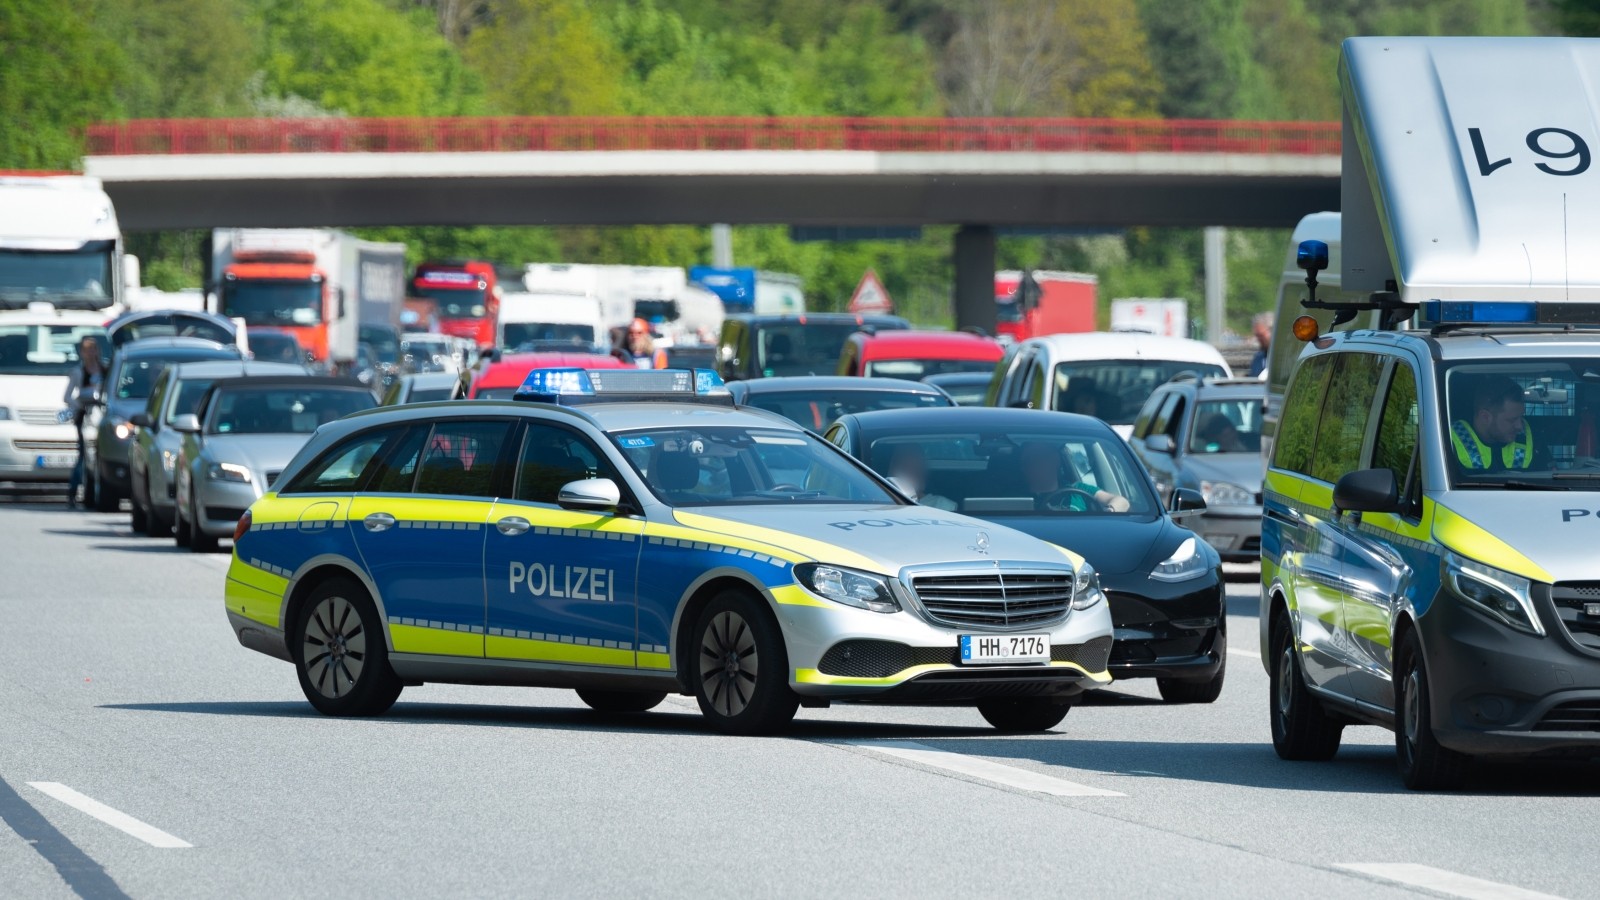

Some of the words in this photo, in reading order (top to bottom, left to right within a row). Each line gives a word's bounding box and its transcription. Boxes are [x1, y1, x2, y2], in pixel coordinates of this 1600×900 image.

[1562, 509, 1600, 522] P
[509, 561, 614, 602] POLIZEI
[979, 638, 1000, 657] HH
[1010, 637, 1044, 656] 7176
